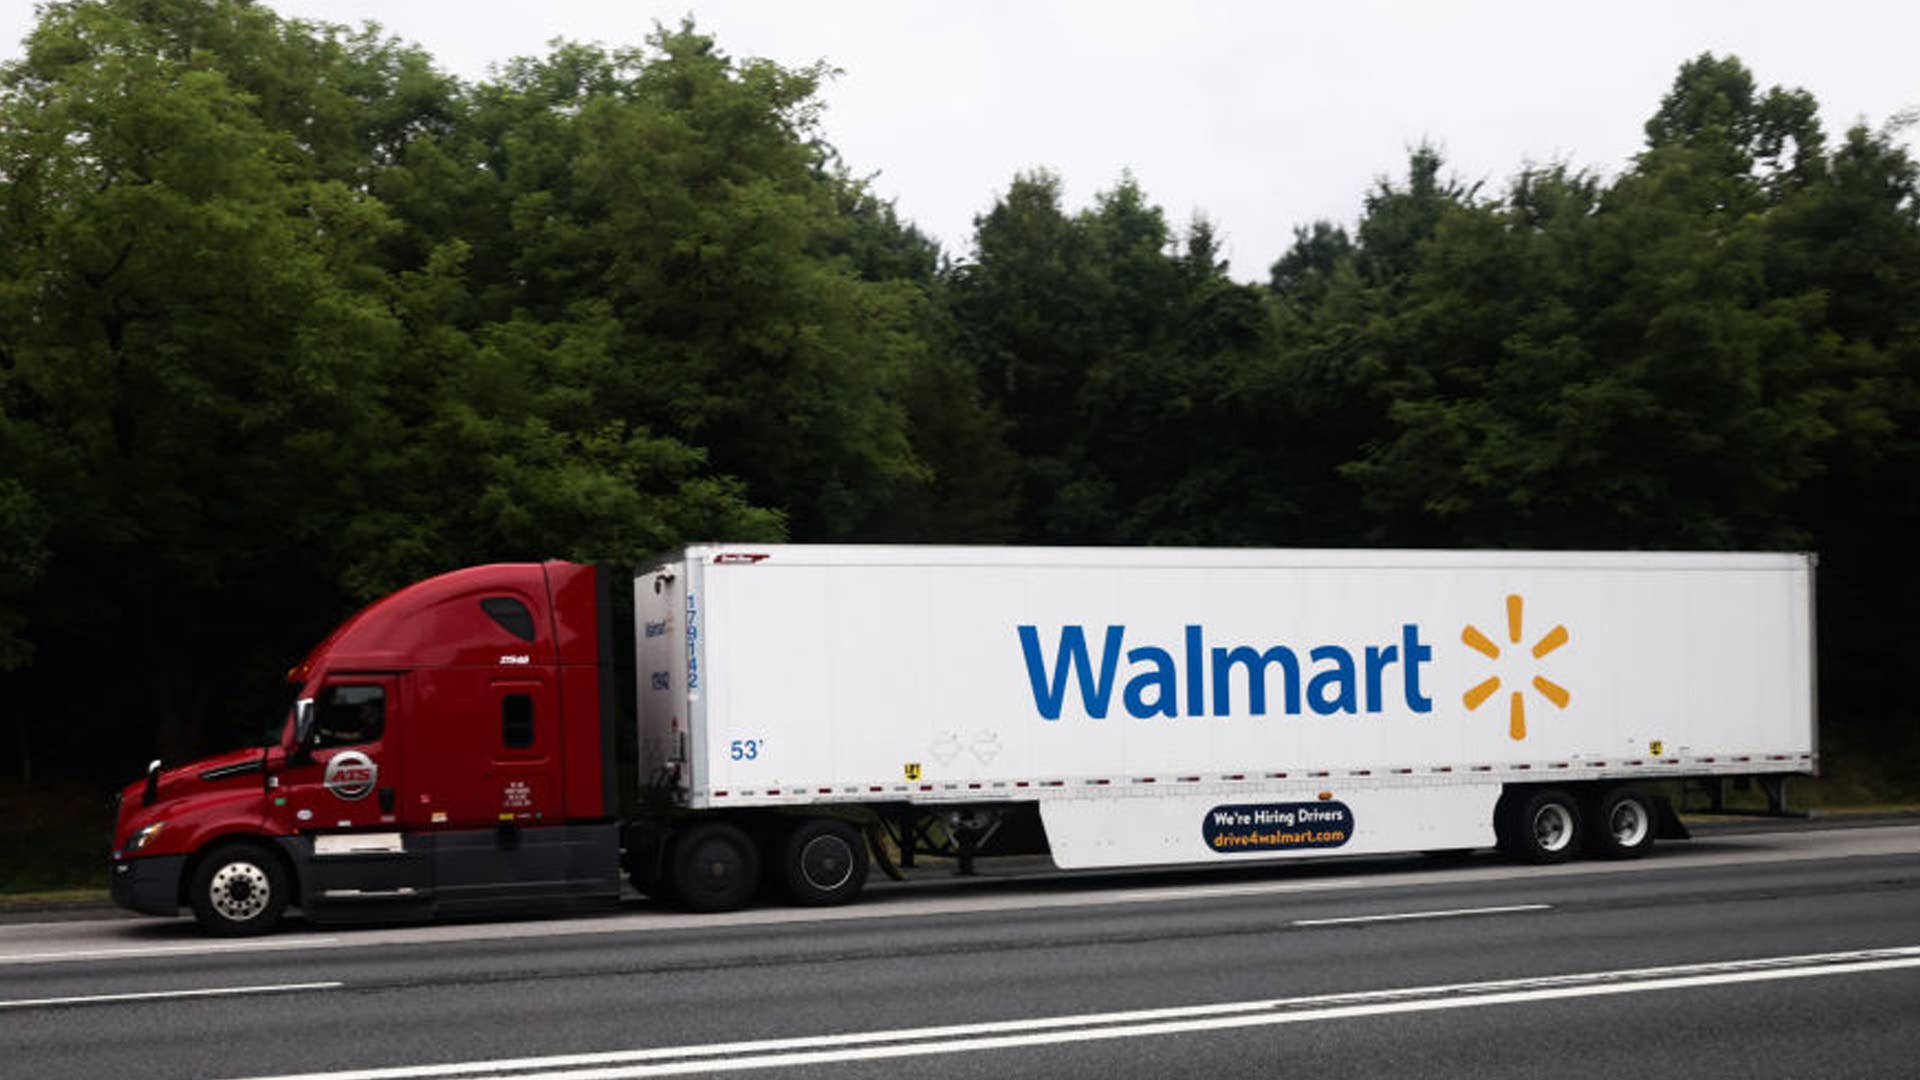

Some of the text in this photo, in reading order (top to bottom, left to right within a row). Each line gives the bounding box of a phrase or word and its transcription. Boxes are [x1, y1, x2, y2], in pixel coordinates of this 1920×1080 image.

[1017, 624, 1432, 720] Walmart
[331, 769, 370, 783] ATS
[1214, 808, 1343, 827] We're Hiring Drivers
[1214, 829, 1344, 847] drive4walmart.com
